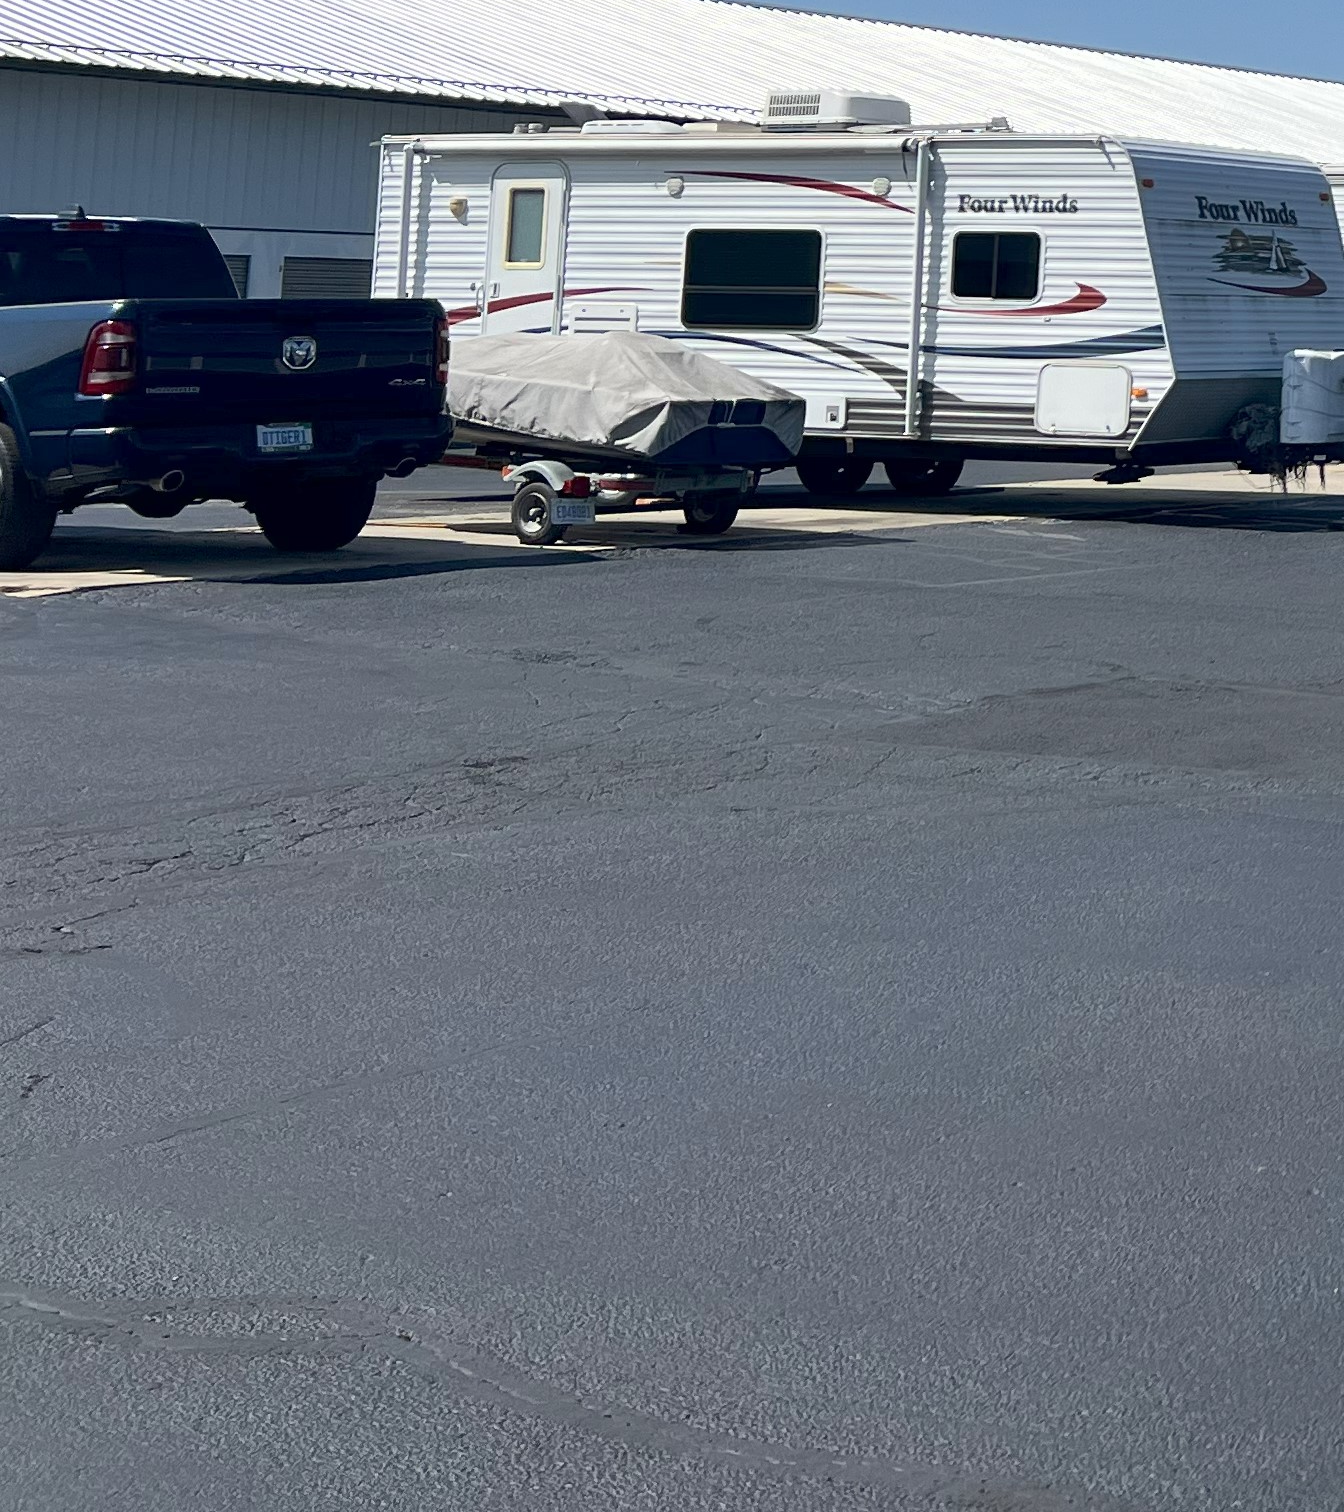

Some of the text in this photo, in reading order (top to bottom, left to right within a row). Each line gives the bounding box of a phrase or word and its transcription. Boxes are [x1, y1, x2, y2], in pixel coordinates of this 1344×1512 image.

[957, 192, 1080, 214] Four Winds
[1194, 195, 1298, 225] Four Winds
